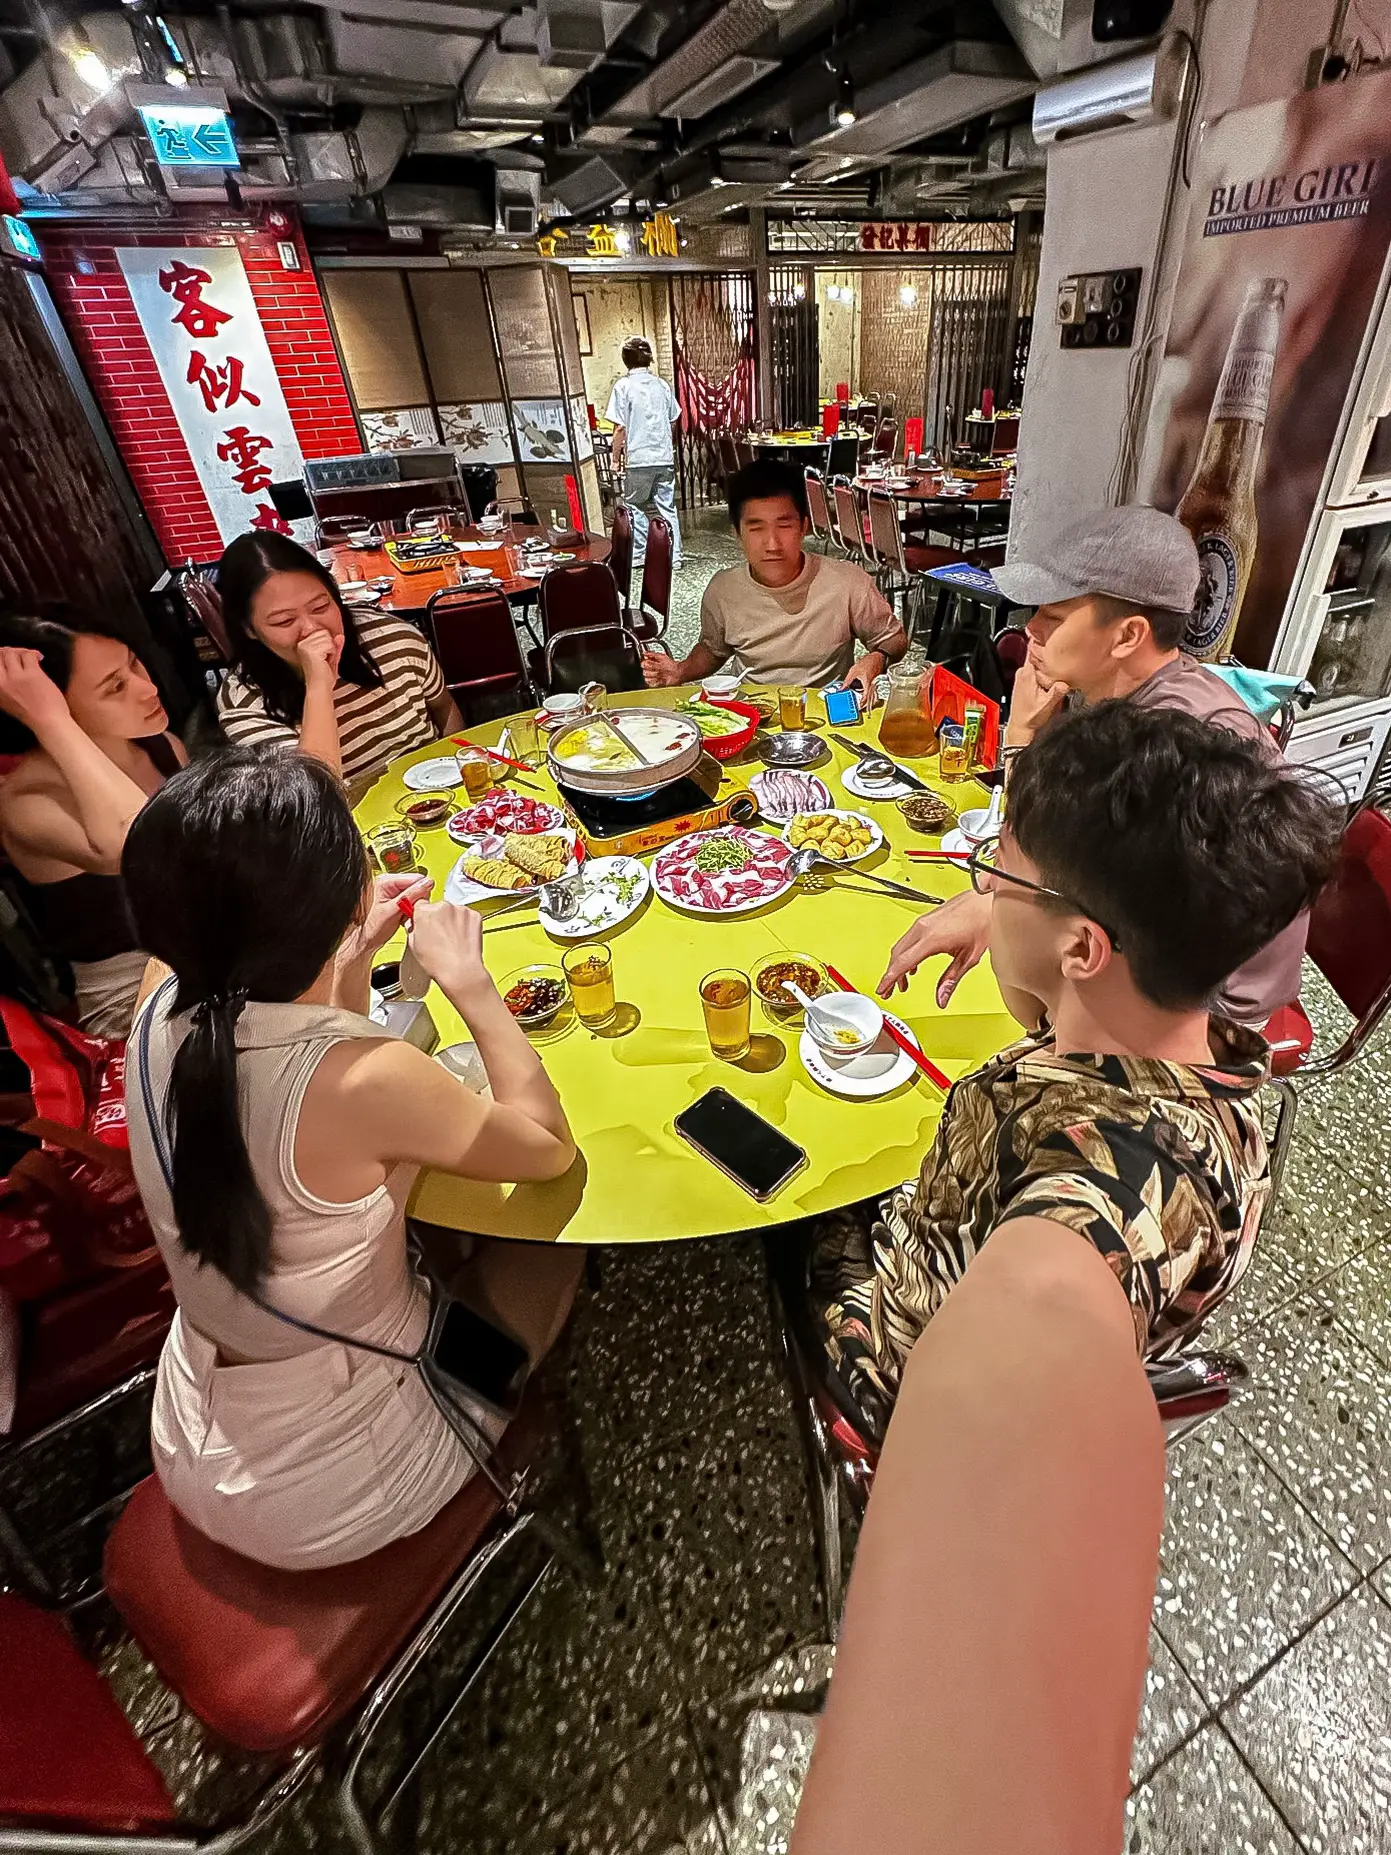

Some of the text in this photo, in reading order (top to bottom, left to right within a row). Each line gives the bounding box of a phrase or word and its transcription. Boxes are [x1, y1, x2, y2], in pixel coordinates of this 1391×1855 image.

[1208, 175, 1286, 217] BLUE
[1206, 200, 1370, 235] IMPORTED PREMIUM BEER
